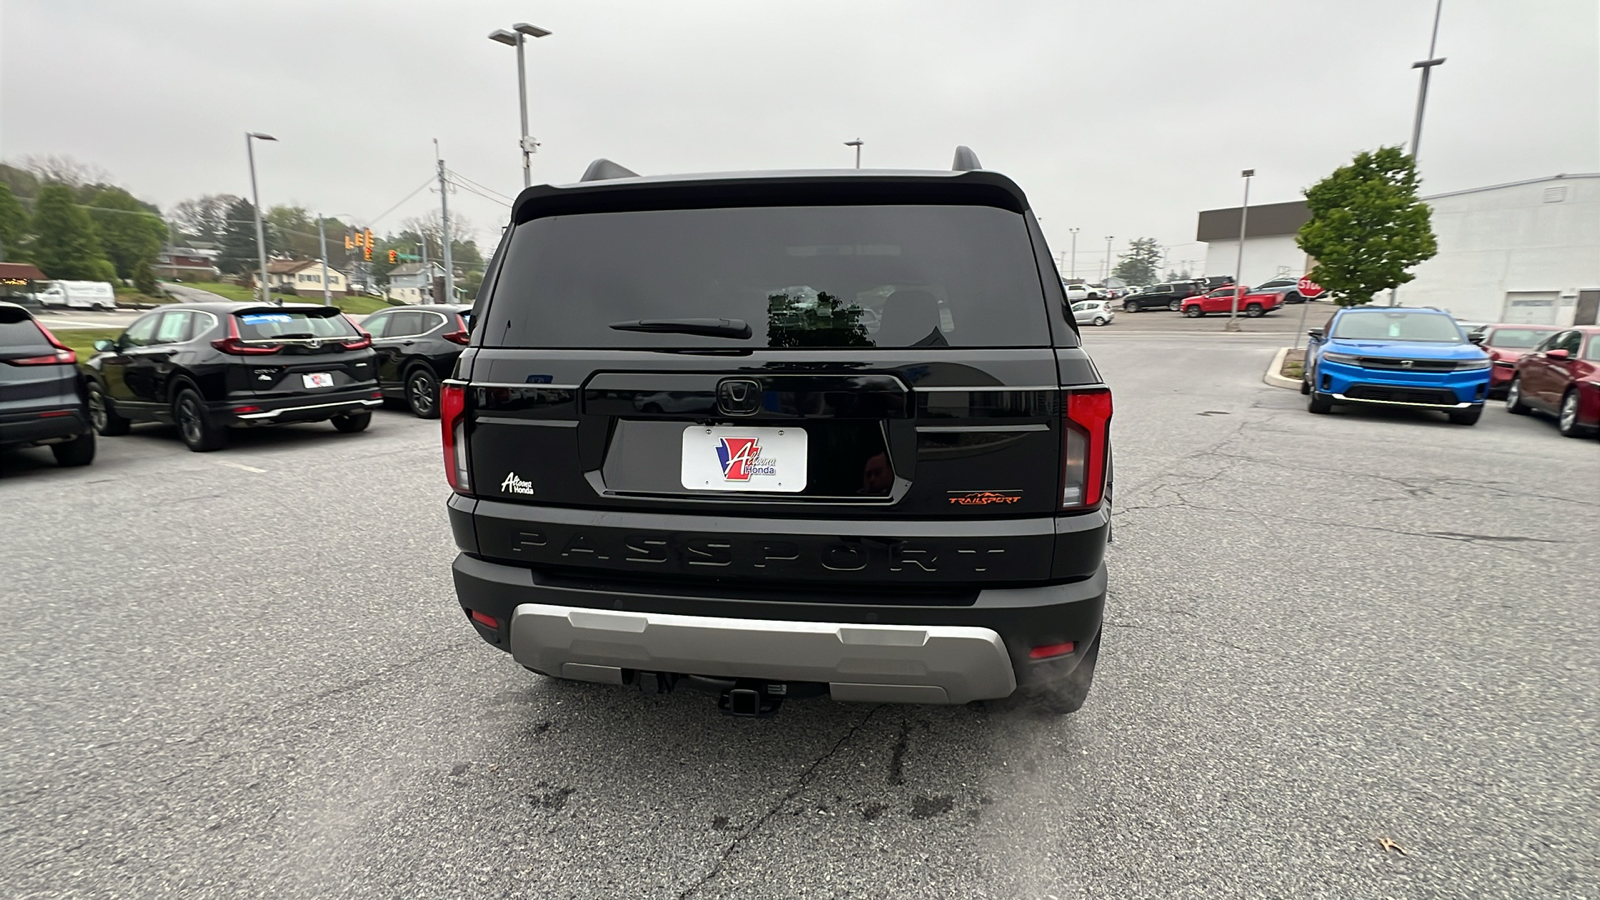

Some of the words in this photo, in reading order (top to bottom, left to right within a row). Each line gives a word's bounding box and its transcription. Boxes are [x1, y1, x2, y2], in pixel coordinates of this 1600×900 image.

[725, 441, 776, 475] Altoona
[745, 465, 775, 475] Honda
[514, 487, 534, 495] Honda
[949, 496, 1021, 505] TRAILSPORT
[510, 530, 1005, 573] PASSPORT
